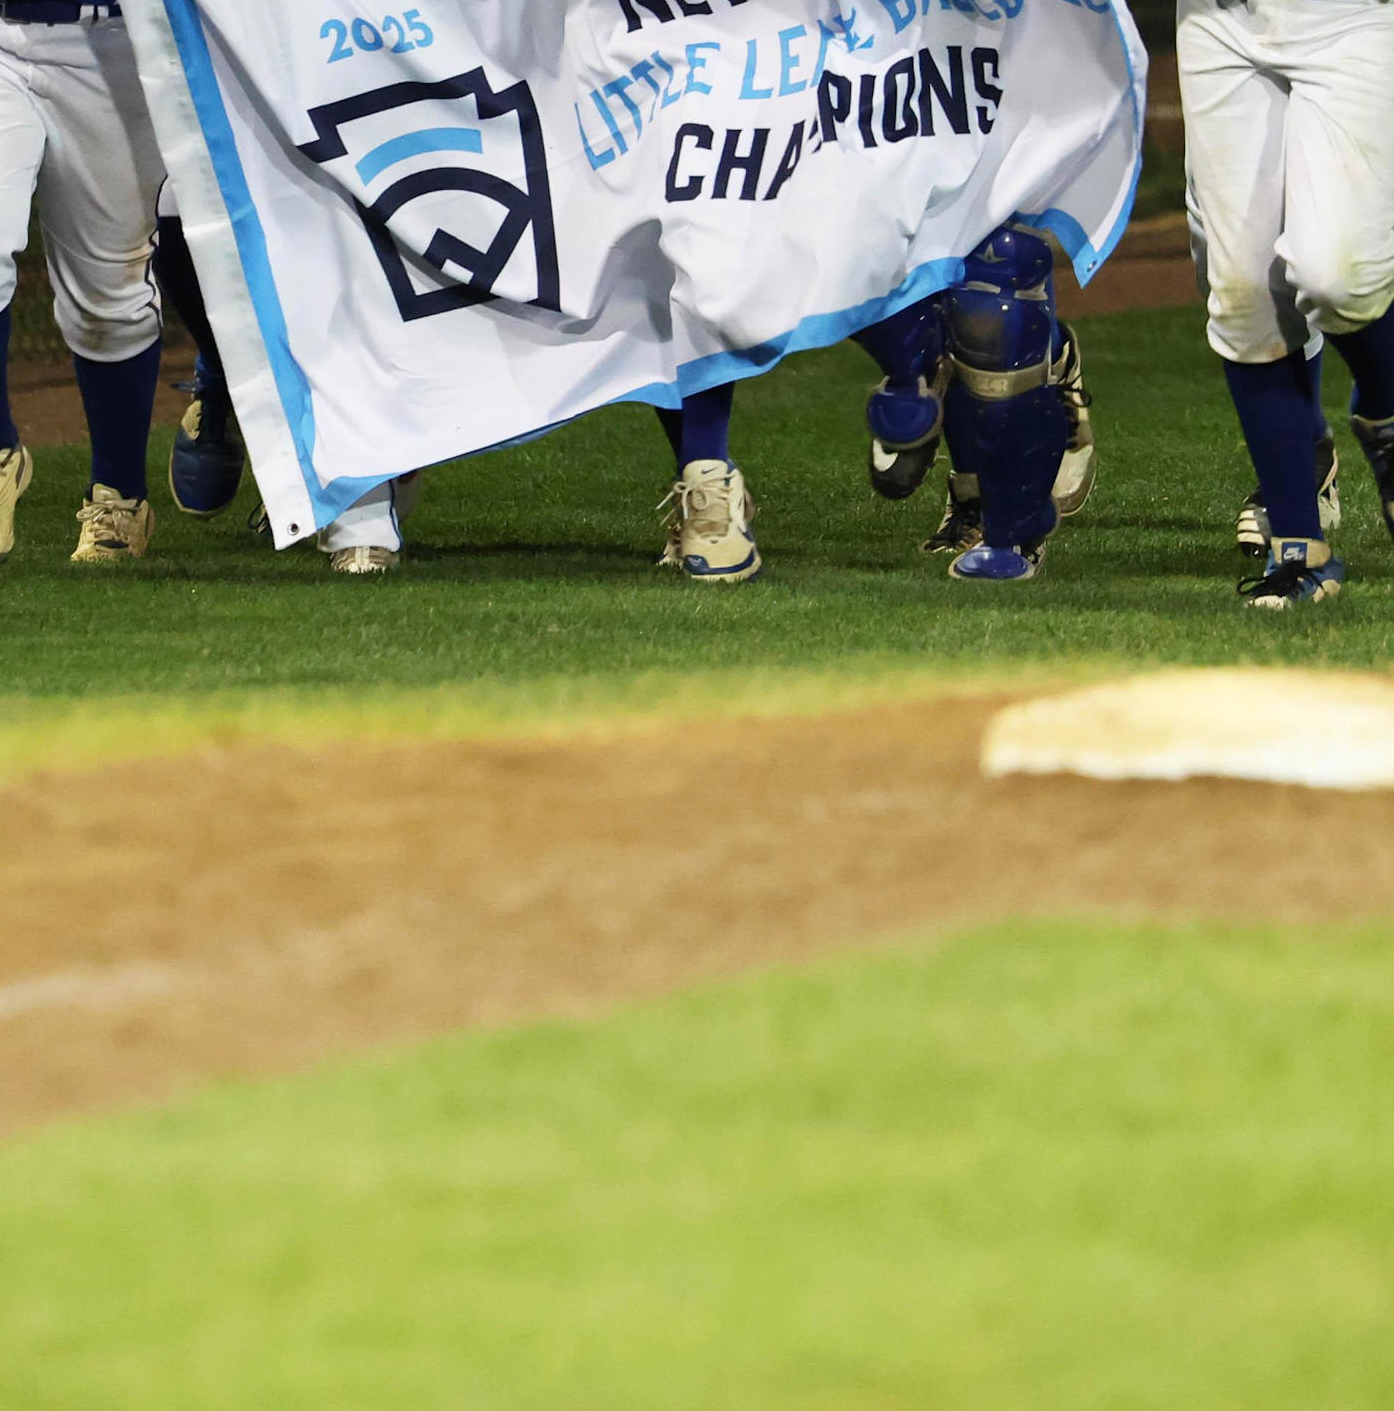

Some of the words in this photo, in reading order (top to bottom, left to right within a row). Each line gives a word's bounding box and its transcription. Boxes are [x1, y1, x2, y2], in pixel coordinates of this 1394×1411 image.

[319, 8, 434, 64] 2025
[574, 41, 721, 171] LITTLE
[665, 45, 1004, 203] CHAPIONS
